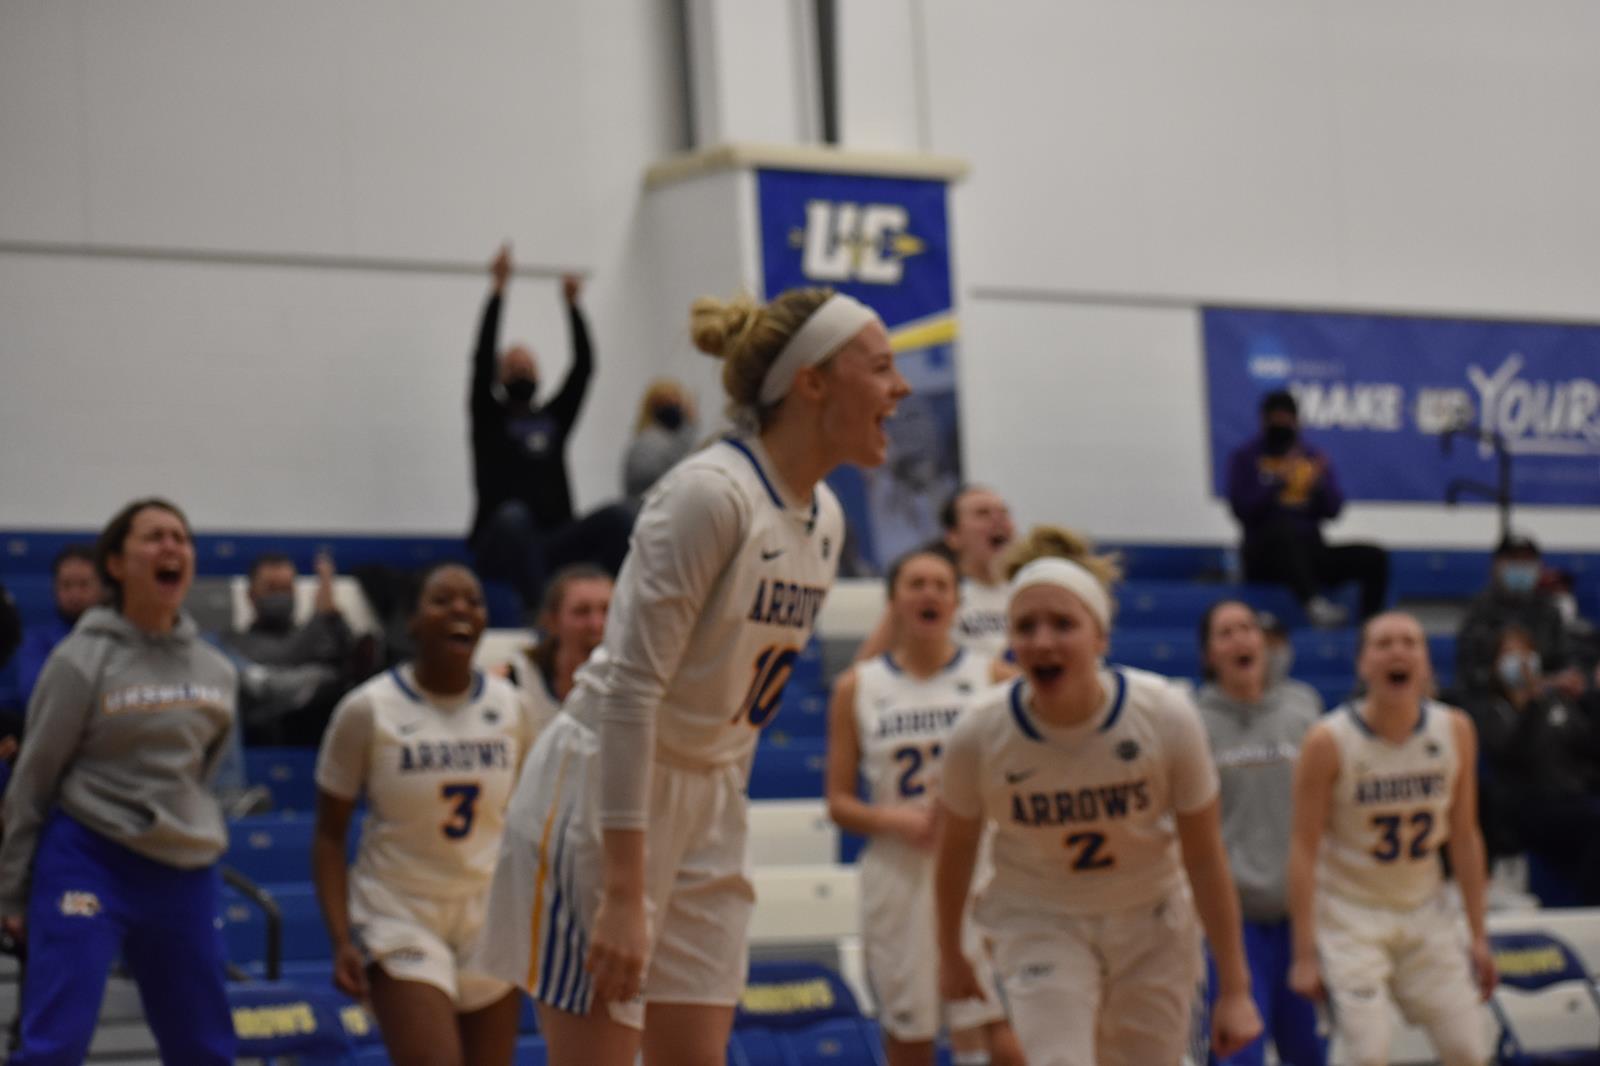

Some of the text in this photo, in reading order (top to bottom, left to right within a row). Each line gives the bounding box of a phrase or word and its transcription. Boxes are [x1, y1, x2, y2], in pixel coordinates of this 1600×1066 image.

[803, 198, 909, 285] UC
[748, 577, 828, 628] ARROW
[730, 645, 800, 727] 10
[876, 707, 960, 738] ARROW
[894, 743, 943, 799] 2
[439, 781, 481, 838] 3
[1011, 779, 1151, 827] ARROWS
[1065, 830, 1116, 872] 2
[1372, 811, 1434, 863] 32
